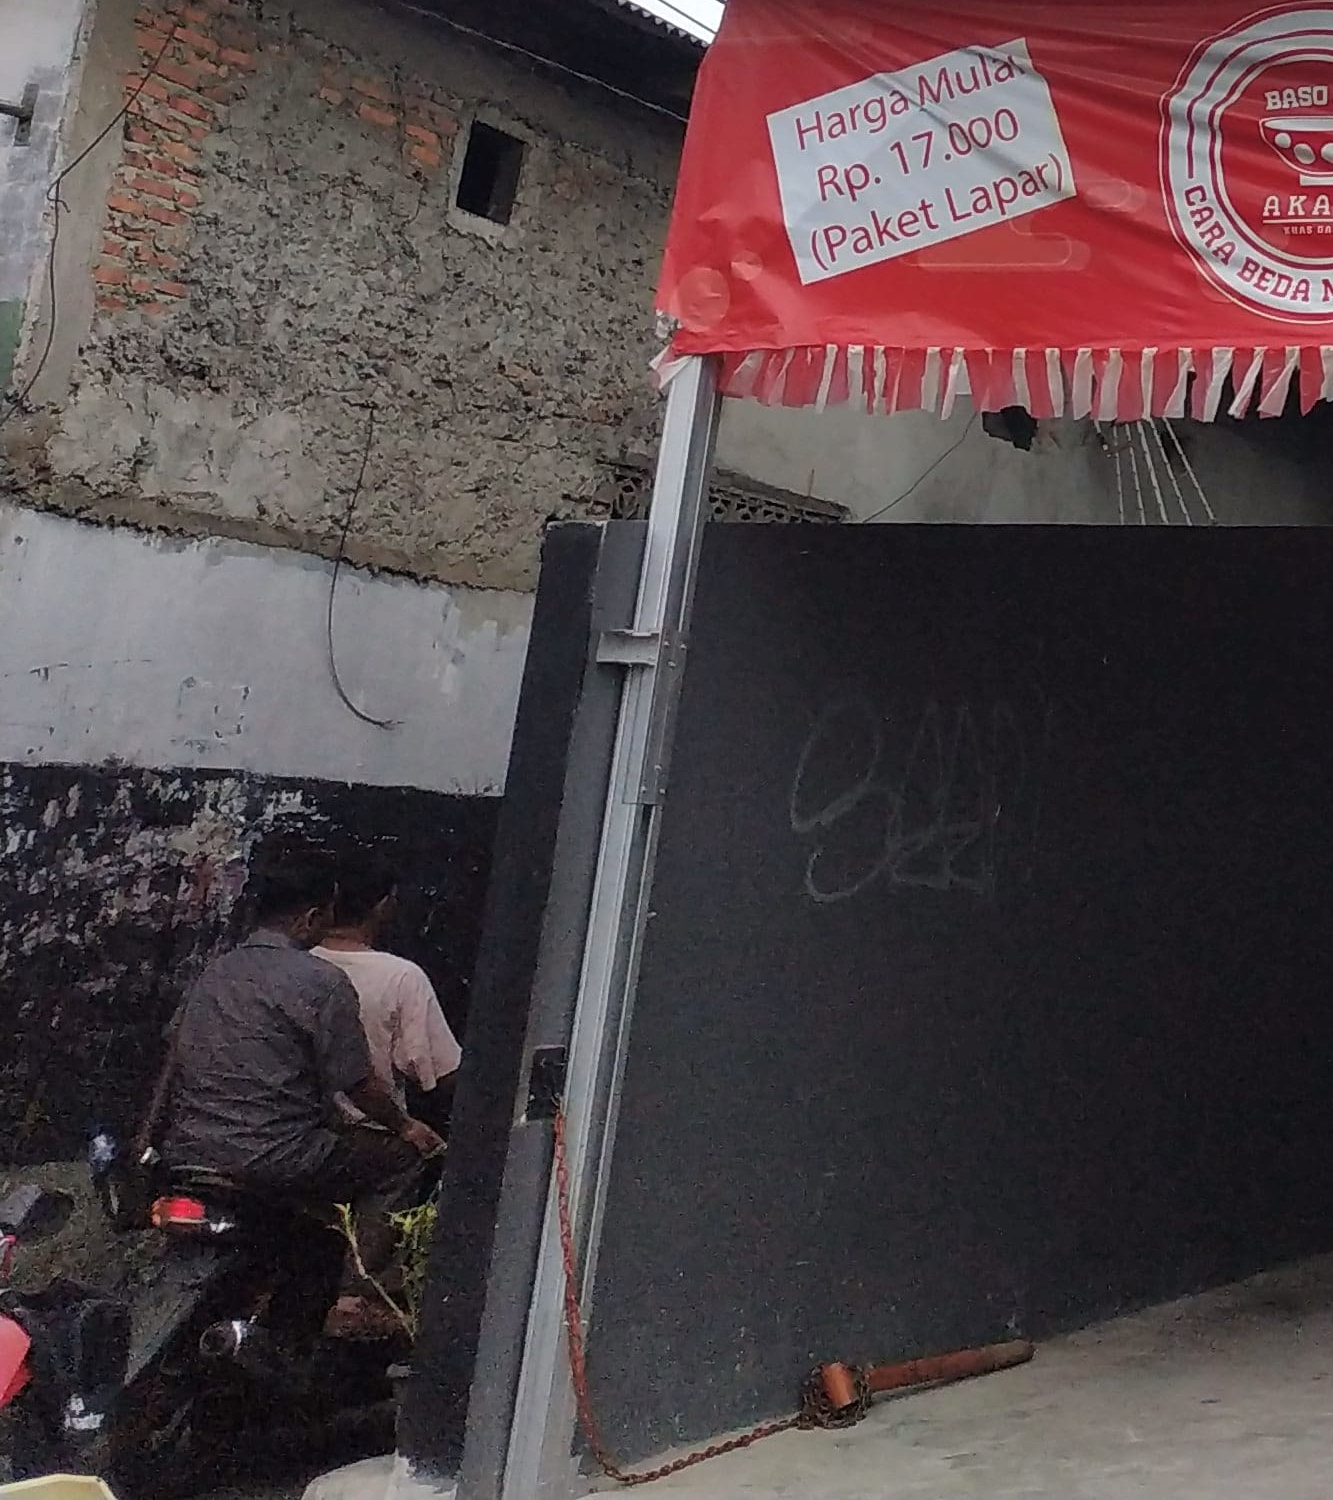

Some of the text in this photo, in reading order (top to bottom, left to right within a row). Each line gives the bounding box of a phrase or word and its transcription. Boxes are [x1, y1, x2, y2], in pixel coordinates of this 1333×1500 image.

[795, 89, 910, 151] Harga
[1265, 85, 1329, 111] BASO
[816, 107, 1020, 202] Rp. 17.000
[810, 152, 1063, 272] (Paket Lapar)
[1184, 185, 1238, 267] CARA
[1236, 256, 1312, 303] BEDA
